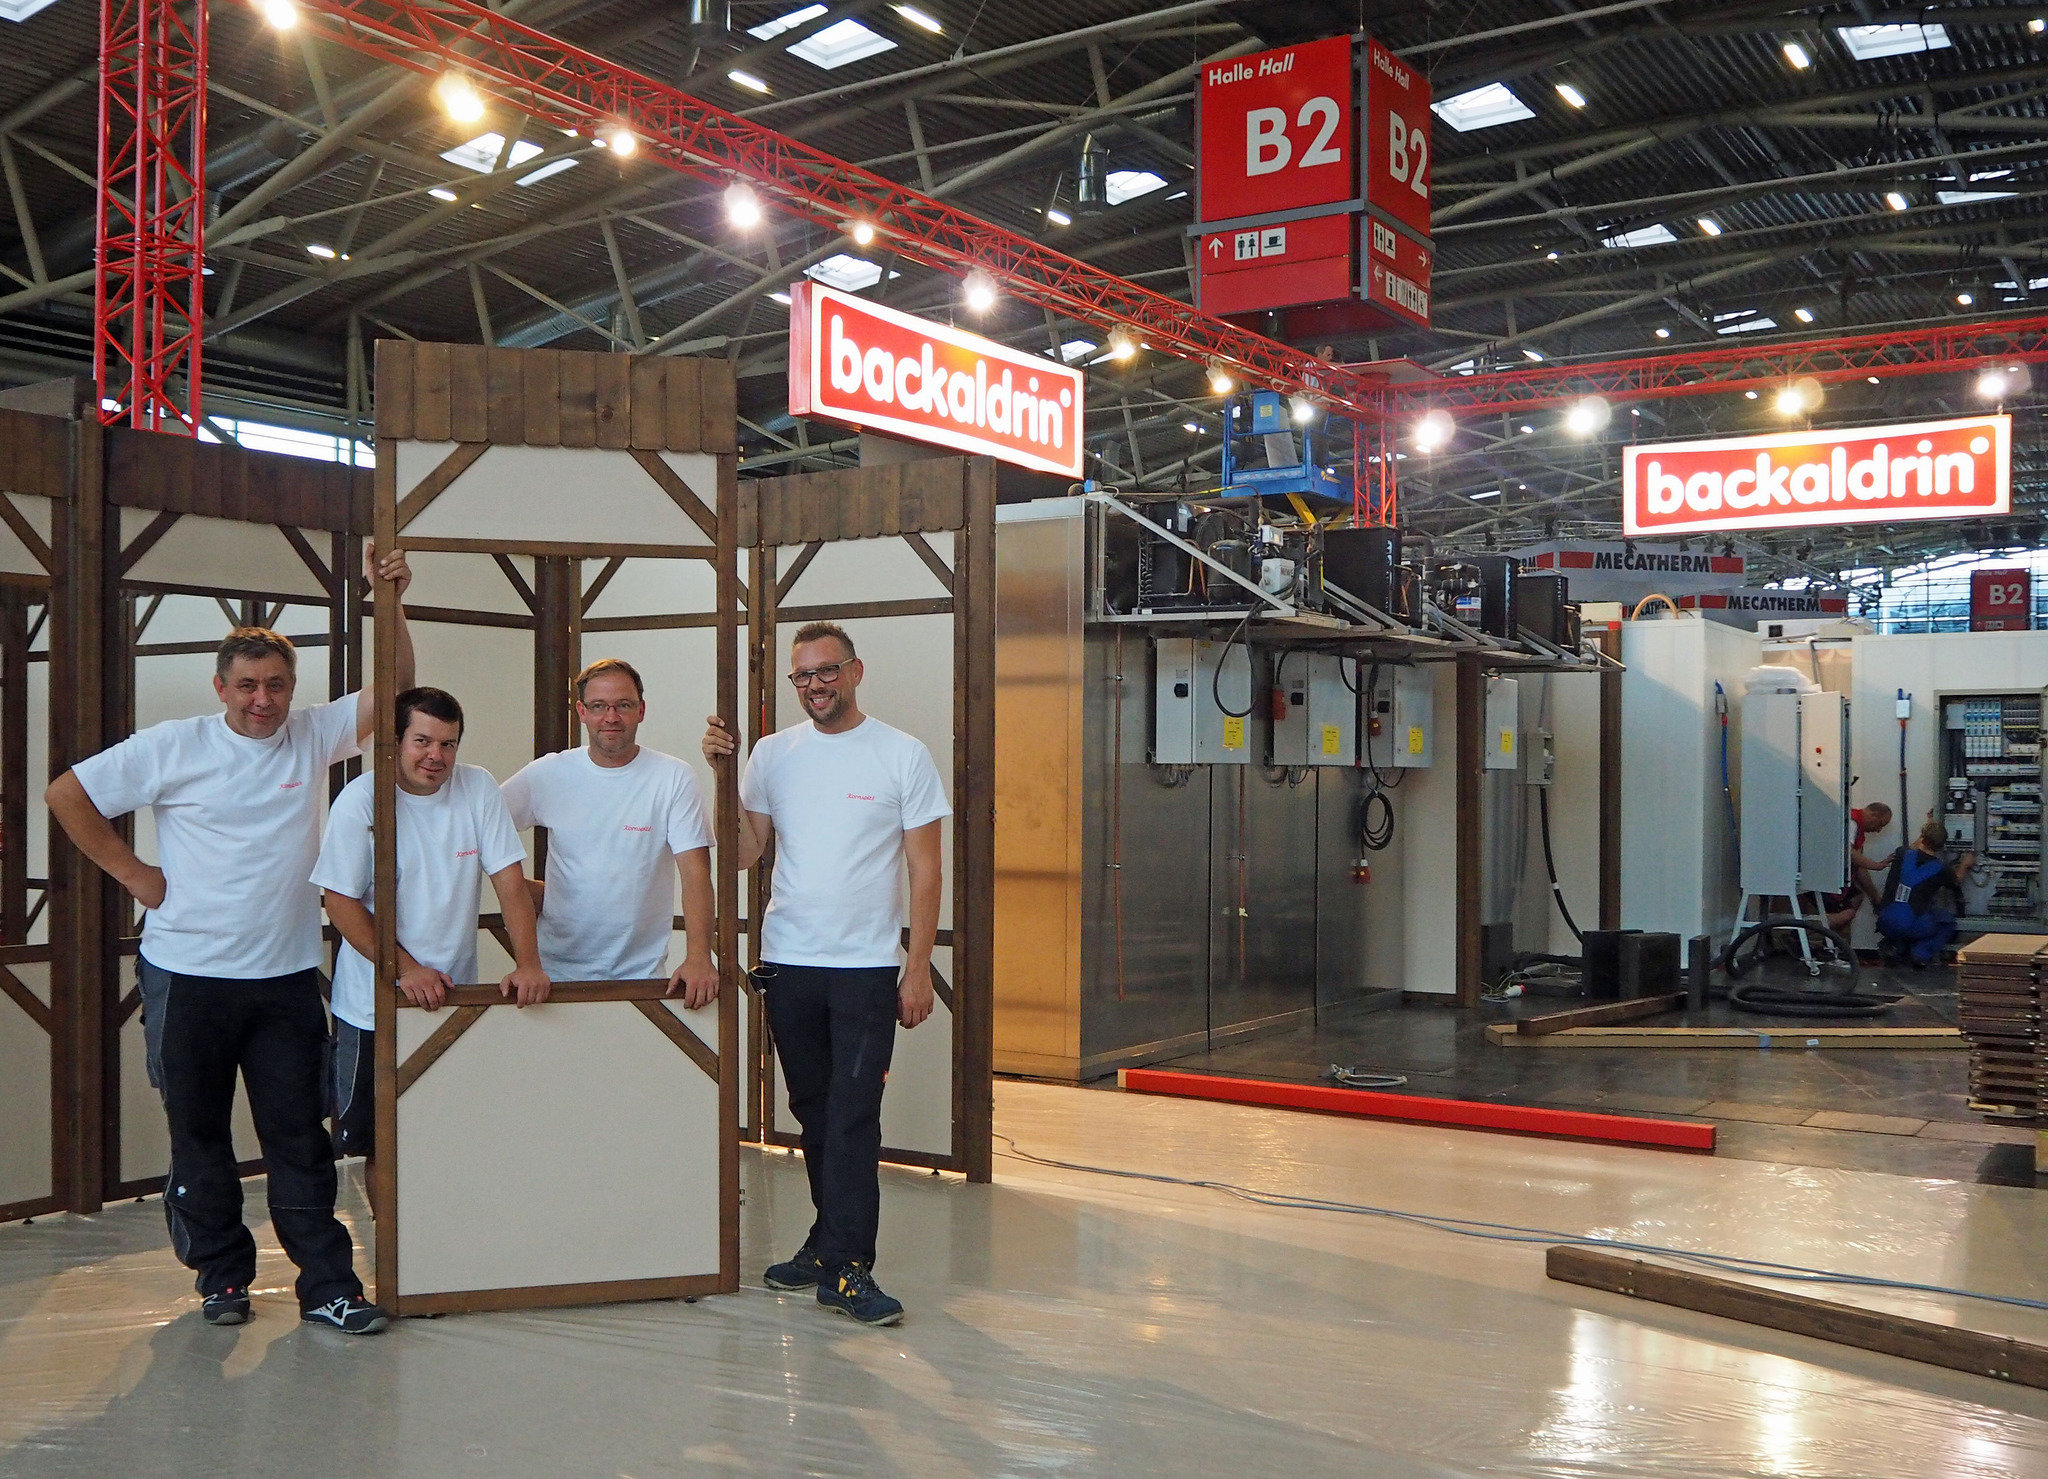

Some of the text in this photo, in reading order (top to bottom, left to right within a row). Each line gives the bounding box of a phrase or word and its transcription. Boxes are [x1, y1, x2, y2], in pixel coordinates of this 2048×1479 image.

[1208, 52, 1295, 87] Halle Hall
[1373, 47, 1410, 90] Halle Hall
[1246, 96, 1341, 177] B2
[1389, 109, 1428, 199] B2
[830, 314, 1071, 449] backaldrin
[1647, 437, 1989, 514] backaldrin
[1595, 551, 1710, 573] MECATHERM
[1727, 595, 1820, 612] MECATHERM
[1989, 583, 2024, 605] B2
